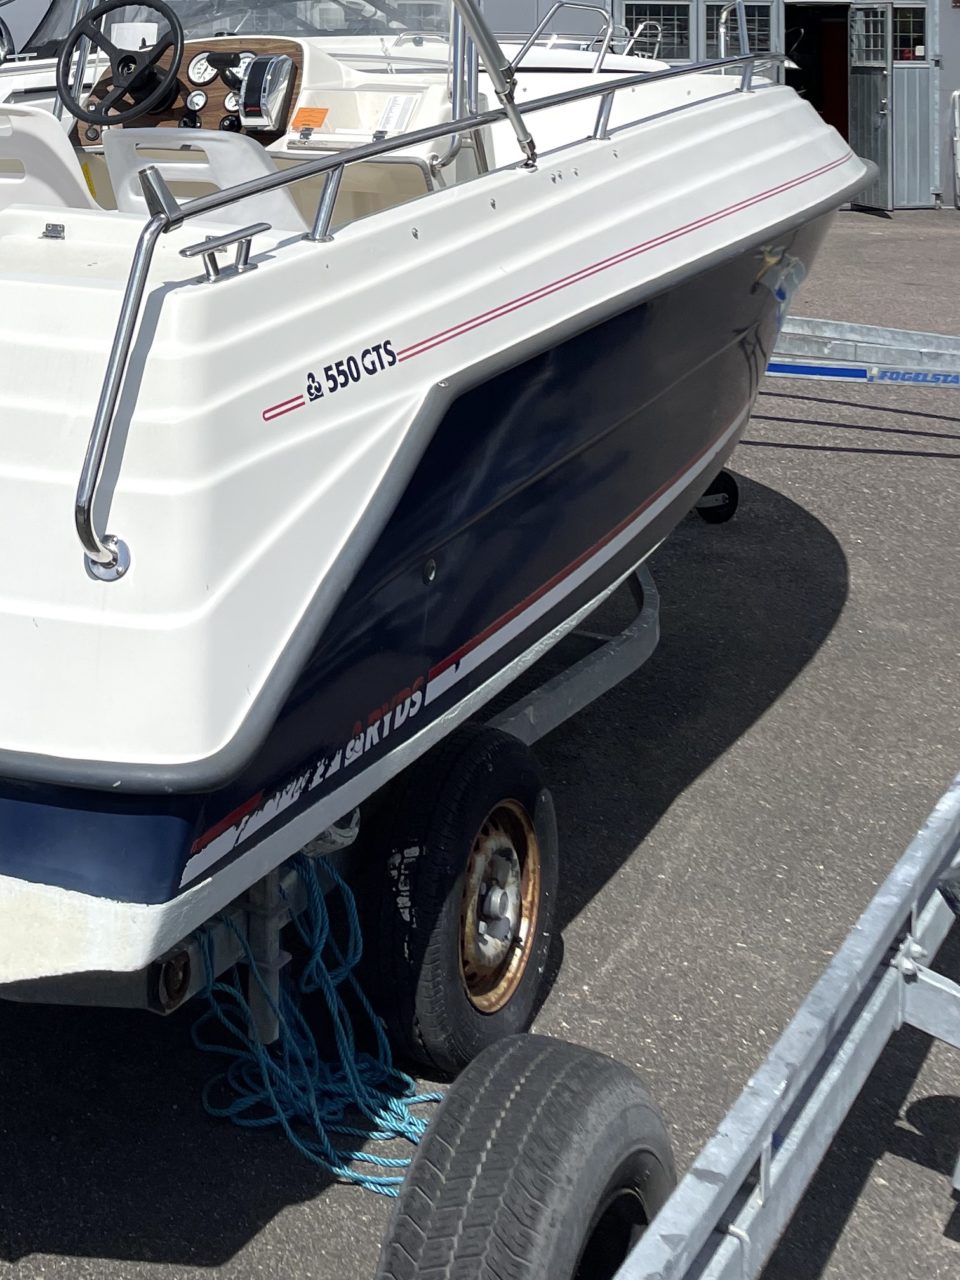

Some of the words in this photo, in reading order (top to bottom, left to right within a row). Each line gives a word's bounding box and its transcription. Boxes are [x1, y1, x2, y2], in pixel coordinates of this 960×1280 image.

[324, 355, 361, 393] 550
[361, 340, 397, 376] GTS
[879, 370, 960, 384] FOGELSTA
